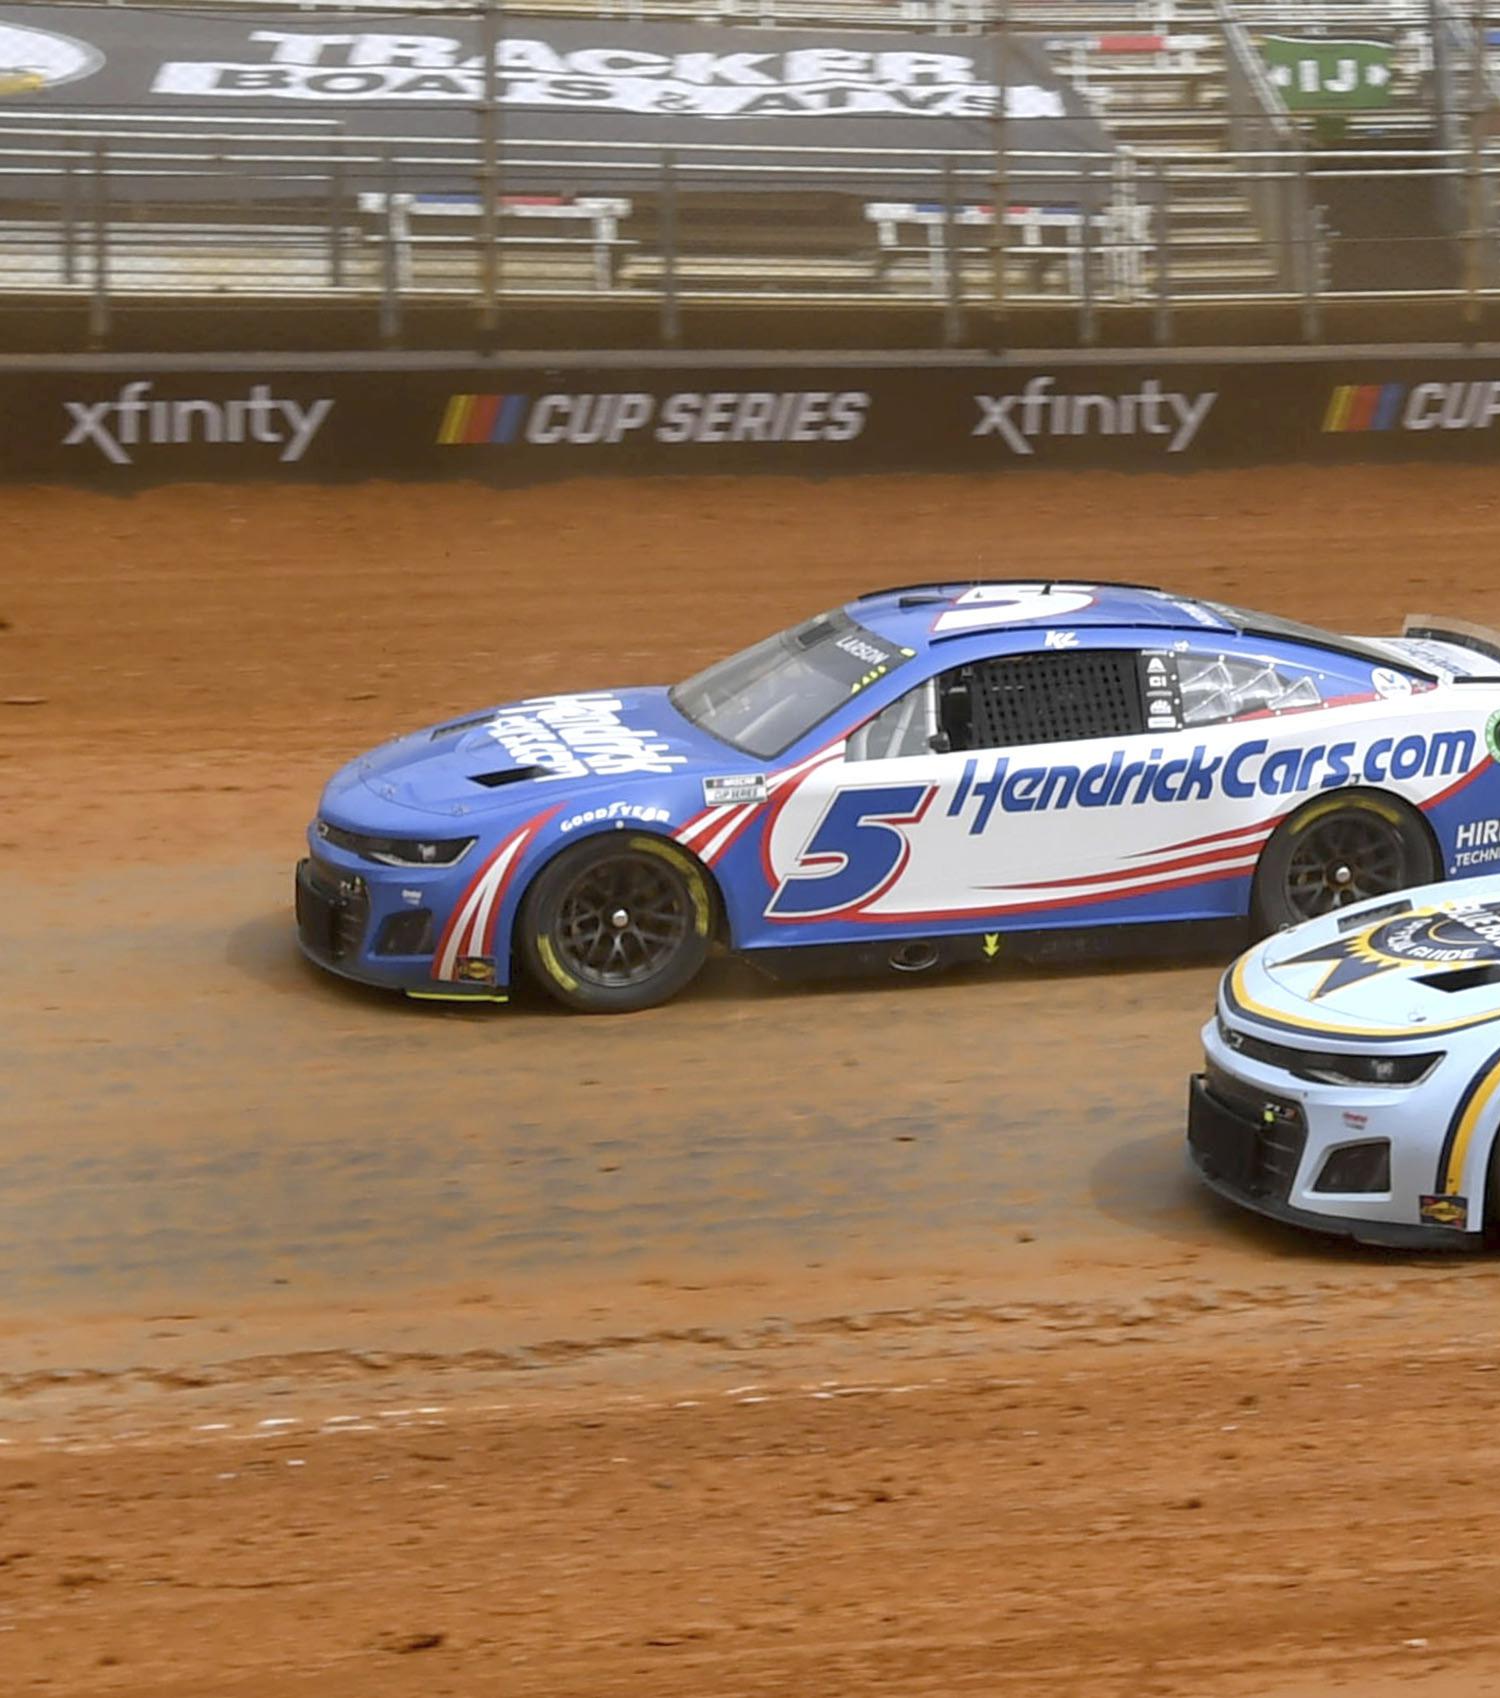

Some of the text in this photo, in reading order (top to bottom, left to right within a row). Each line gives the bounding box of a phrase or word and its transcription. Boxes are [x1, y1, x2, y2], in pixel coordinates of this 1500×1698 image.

[213, 68, 613, 101] BOATS
[249, 31, 976, 85] TRACKER
[1298, 59, 1358, 93] IJ
[62, 381, 335, 464] xfinity
[526, 391, 870, 445] CUP SERIES
[972, 376, 1217, 454] xfinity
[835, 634, 891, 665] LARSON
[946, 729, 1477, 836] HendrickCars.com
[560, 801, 671, 833] GOODYEAR
[764, 780, 940, 924] 5
